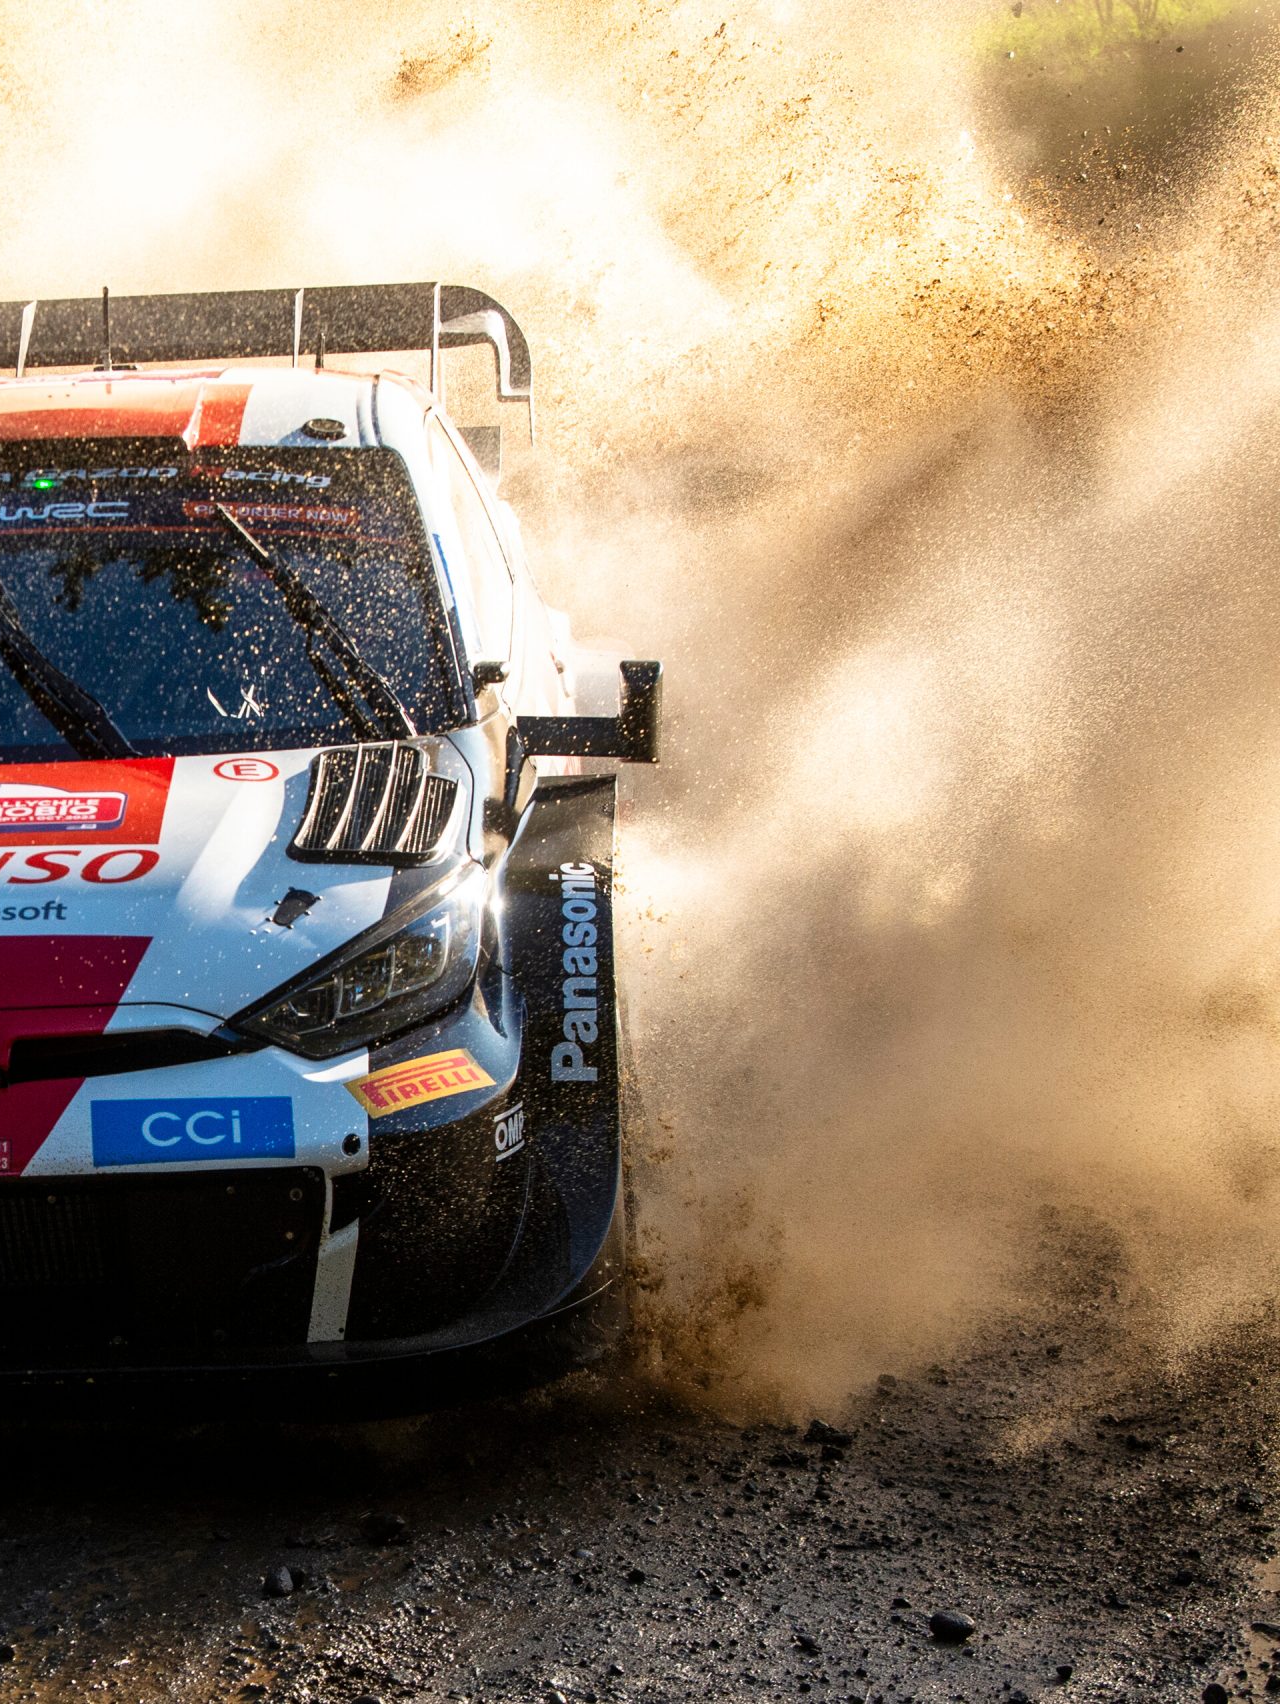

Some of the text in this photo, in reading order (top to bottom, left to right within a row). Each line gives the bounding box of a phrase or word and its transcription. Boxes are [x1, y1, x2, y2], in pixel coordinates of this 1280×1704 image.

[0, 502, 129, 521] WRC
[233, 764, 260, 776] E
[549, 862, 598, 1083] Panasonic
[361, 1056, 483, 1109] PIRELLI
[141, 1110, 241, 1147] CCi
[495, 1115, 524, 1151] OMP
